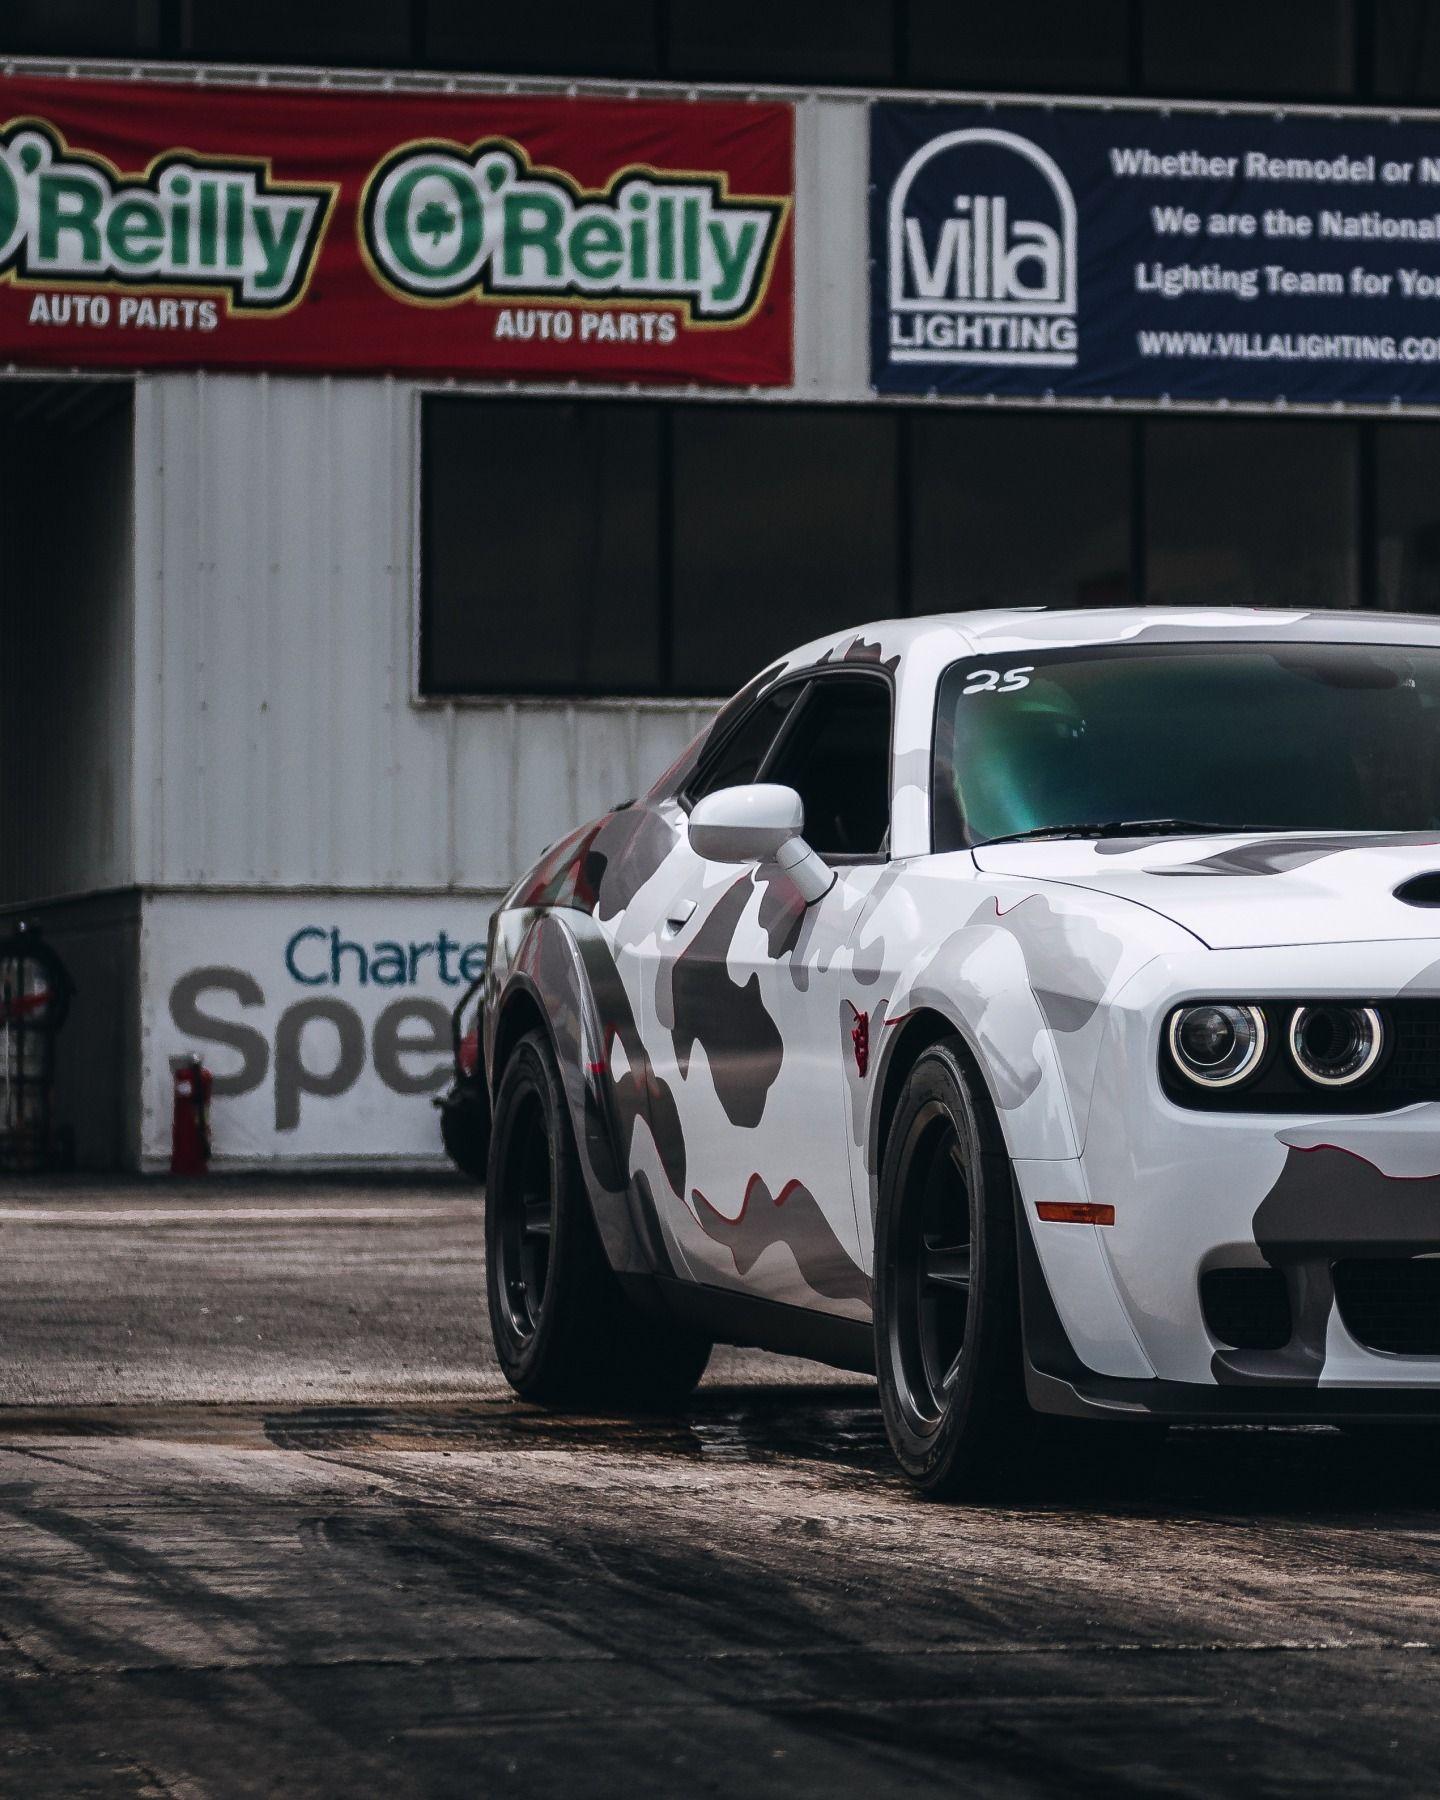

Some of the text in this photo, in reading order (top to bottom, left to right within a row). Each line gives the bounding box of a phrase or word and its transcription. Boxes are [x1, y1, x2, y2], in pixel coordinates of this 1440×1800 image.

[1110, 148, 1238, 178] Whether
[1244, 151, 1376, 183] Remodel
[1382, 160, 1414, 183] or
[0, 143, 305, 288] 'Reilly
[383, 160, 760, 301] O'Reilly
[1151, 206, 1201, 234] We
[1207, 212, 1257, 236] are
[1263, 209, 1313, 237] the
[1135, 262, 1259, 298] Lighting
[1264, 266, 1344, 295] Team
[1350, 267, 1392, 295] for
[28, 292, 219, 333] AUTO PARTS
[495, 308, 677, 346] AUTO PARTS
[890, 315, 1078, 350] LIGHTING
[962, 666, 1035, 695] 25
